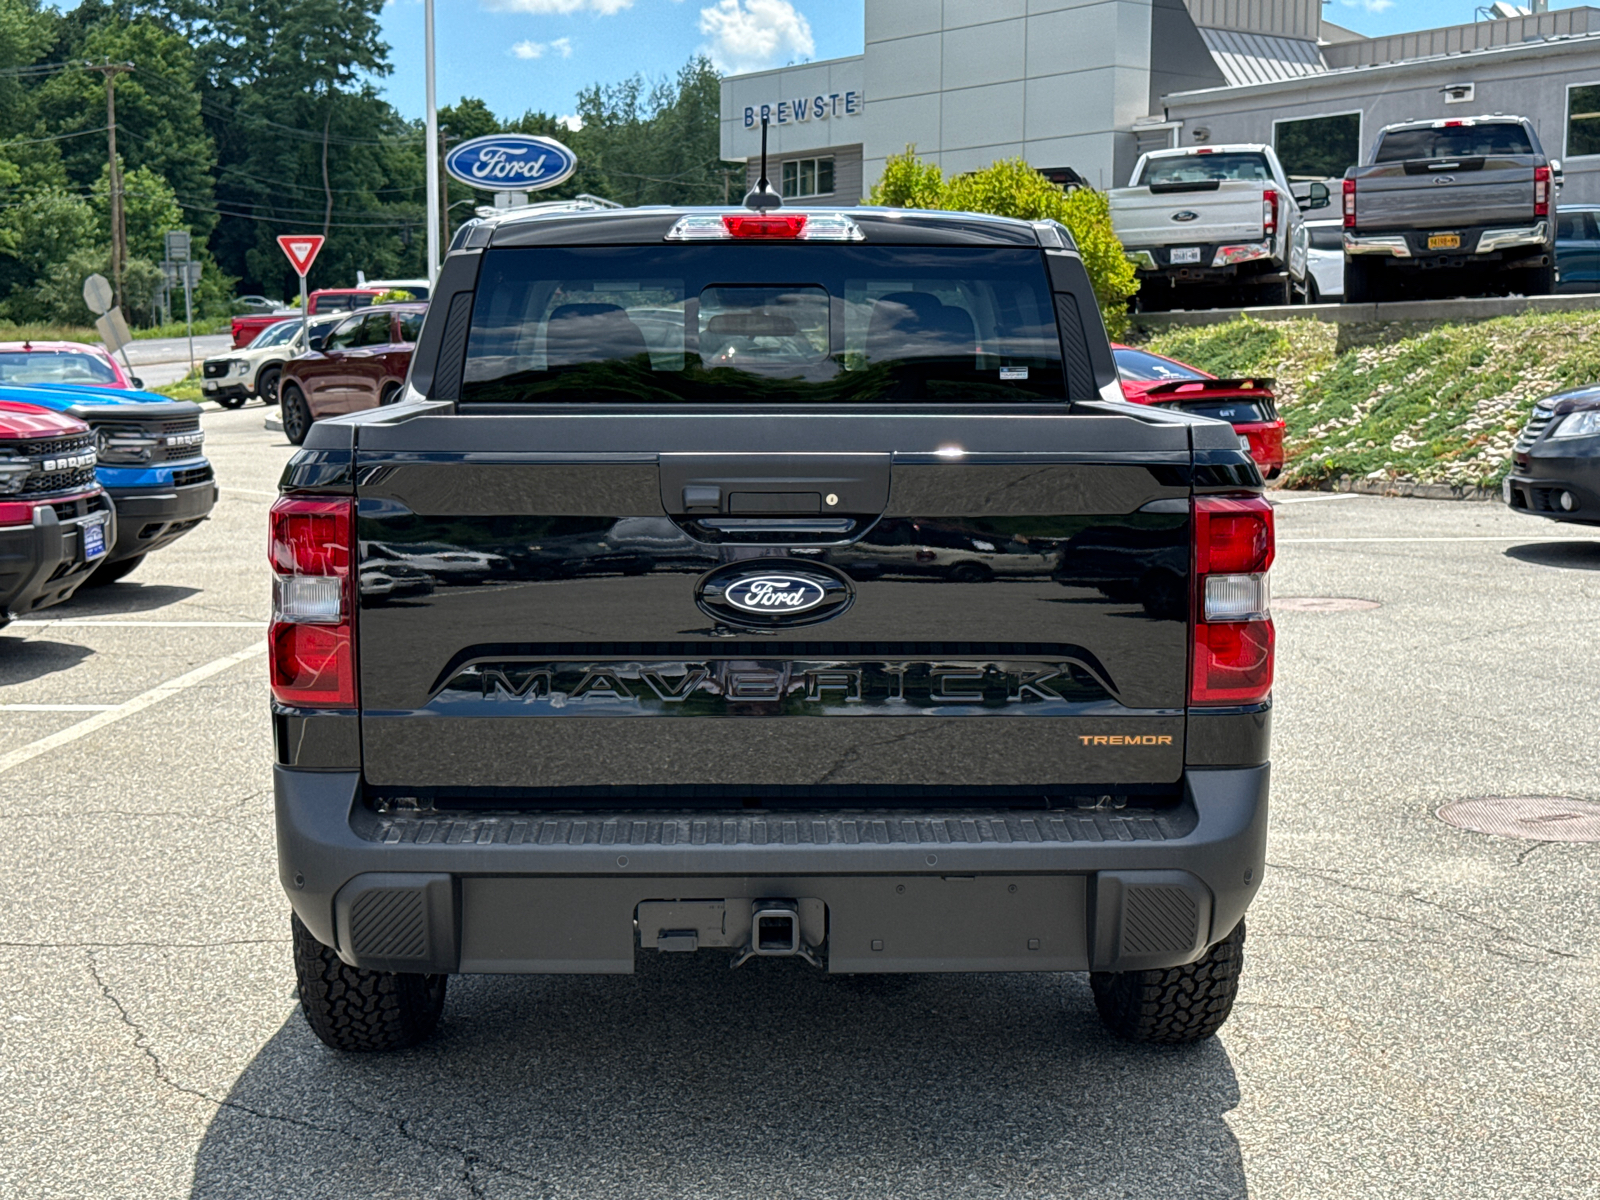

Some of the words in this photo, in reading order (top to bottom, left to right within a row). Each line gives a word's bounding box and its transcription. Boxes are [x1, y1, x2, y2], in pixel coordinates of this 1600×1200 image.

[744, 91, 865, 128] BREWSTE
[471, 146, 547, 178] Ford
[744, 581, 804, 606] Ford
[482, 669, 1068, 702] MAVERICK
[1079, 735, 1173, 746] TREMOR
